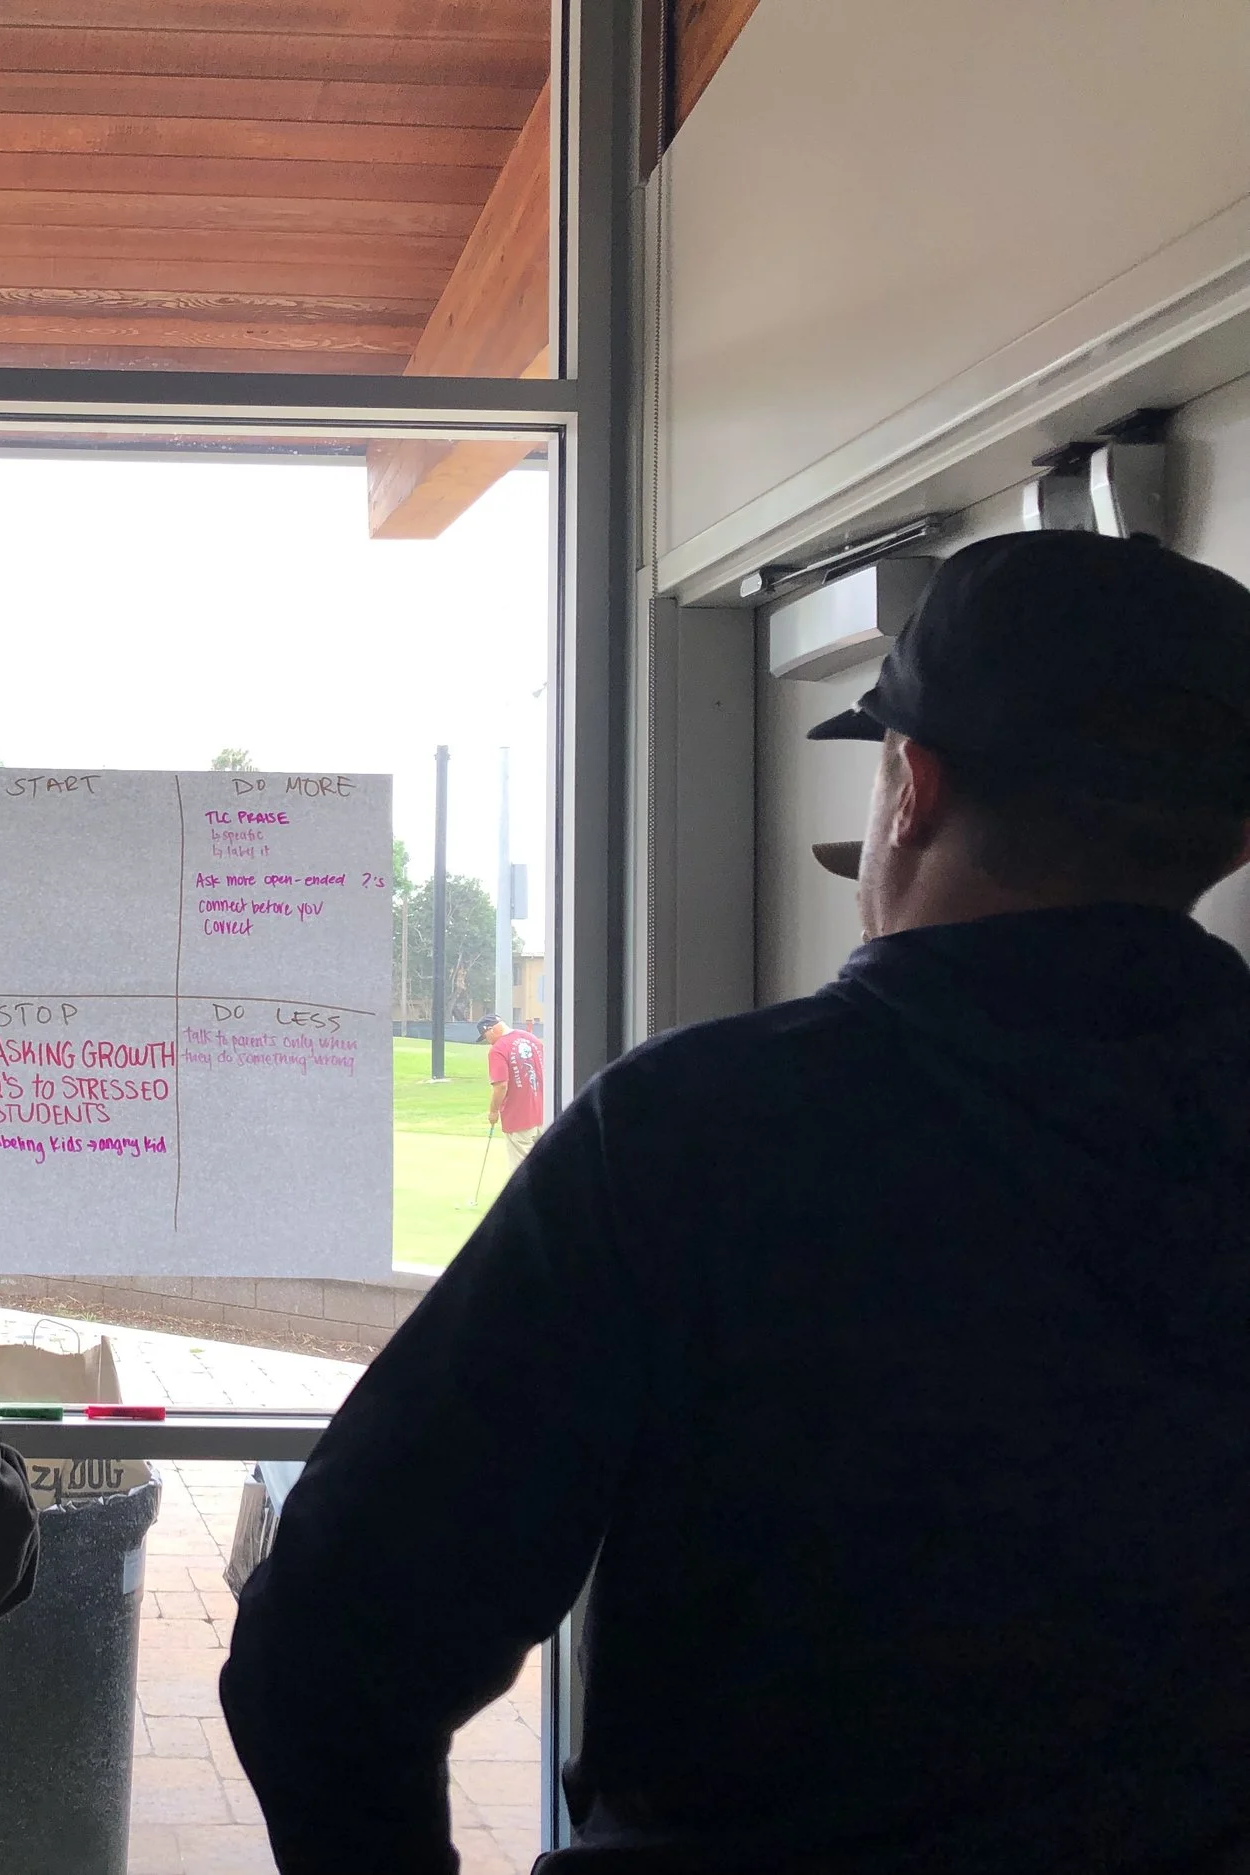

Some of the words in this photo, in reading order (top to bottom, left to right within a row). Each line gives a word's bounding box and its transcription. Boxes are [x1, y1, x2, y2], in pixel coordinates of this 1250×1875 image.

[6, 775, 101, 798] START
[232, 779, 266, 796] DO
[285, 775, 356, 797] MORE
[205, 811, 231, 825] TLC
[238, 811, 290, 825] PRAISE
[196, 872, 220, 888] Ask
[226, 874, 256, 887] more
[252, 899, 293, 916] before
[297, 901, 323, 922] you
[212, 1003, 245, 1022] DO
[276, 1008, 341, 1033] LESS
[183, 1026, 212, 1045] talk
[216, 1030, 228, 1046] to
[232, 1033, 277, 1053] parents
[82, 1040, 176, 1069] GROWTH
[217, 1050, 232, 1063] do
[238, 1051, 307, 1075] something
[62, 1075, 169, 1101] STRESSED
[98, 1136, 141, 1157] angry
